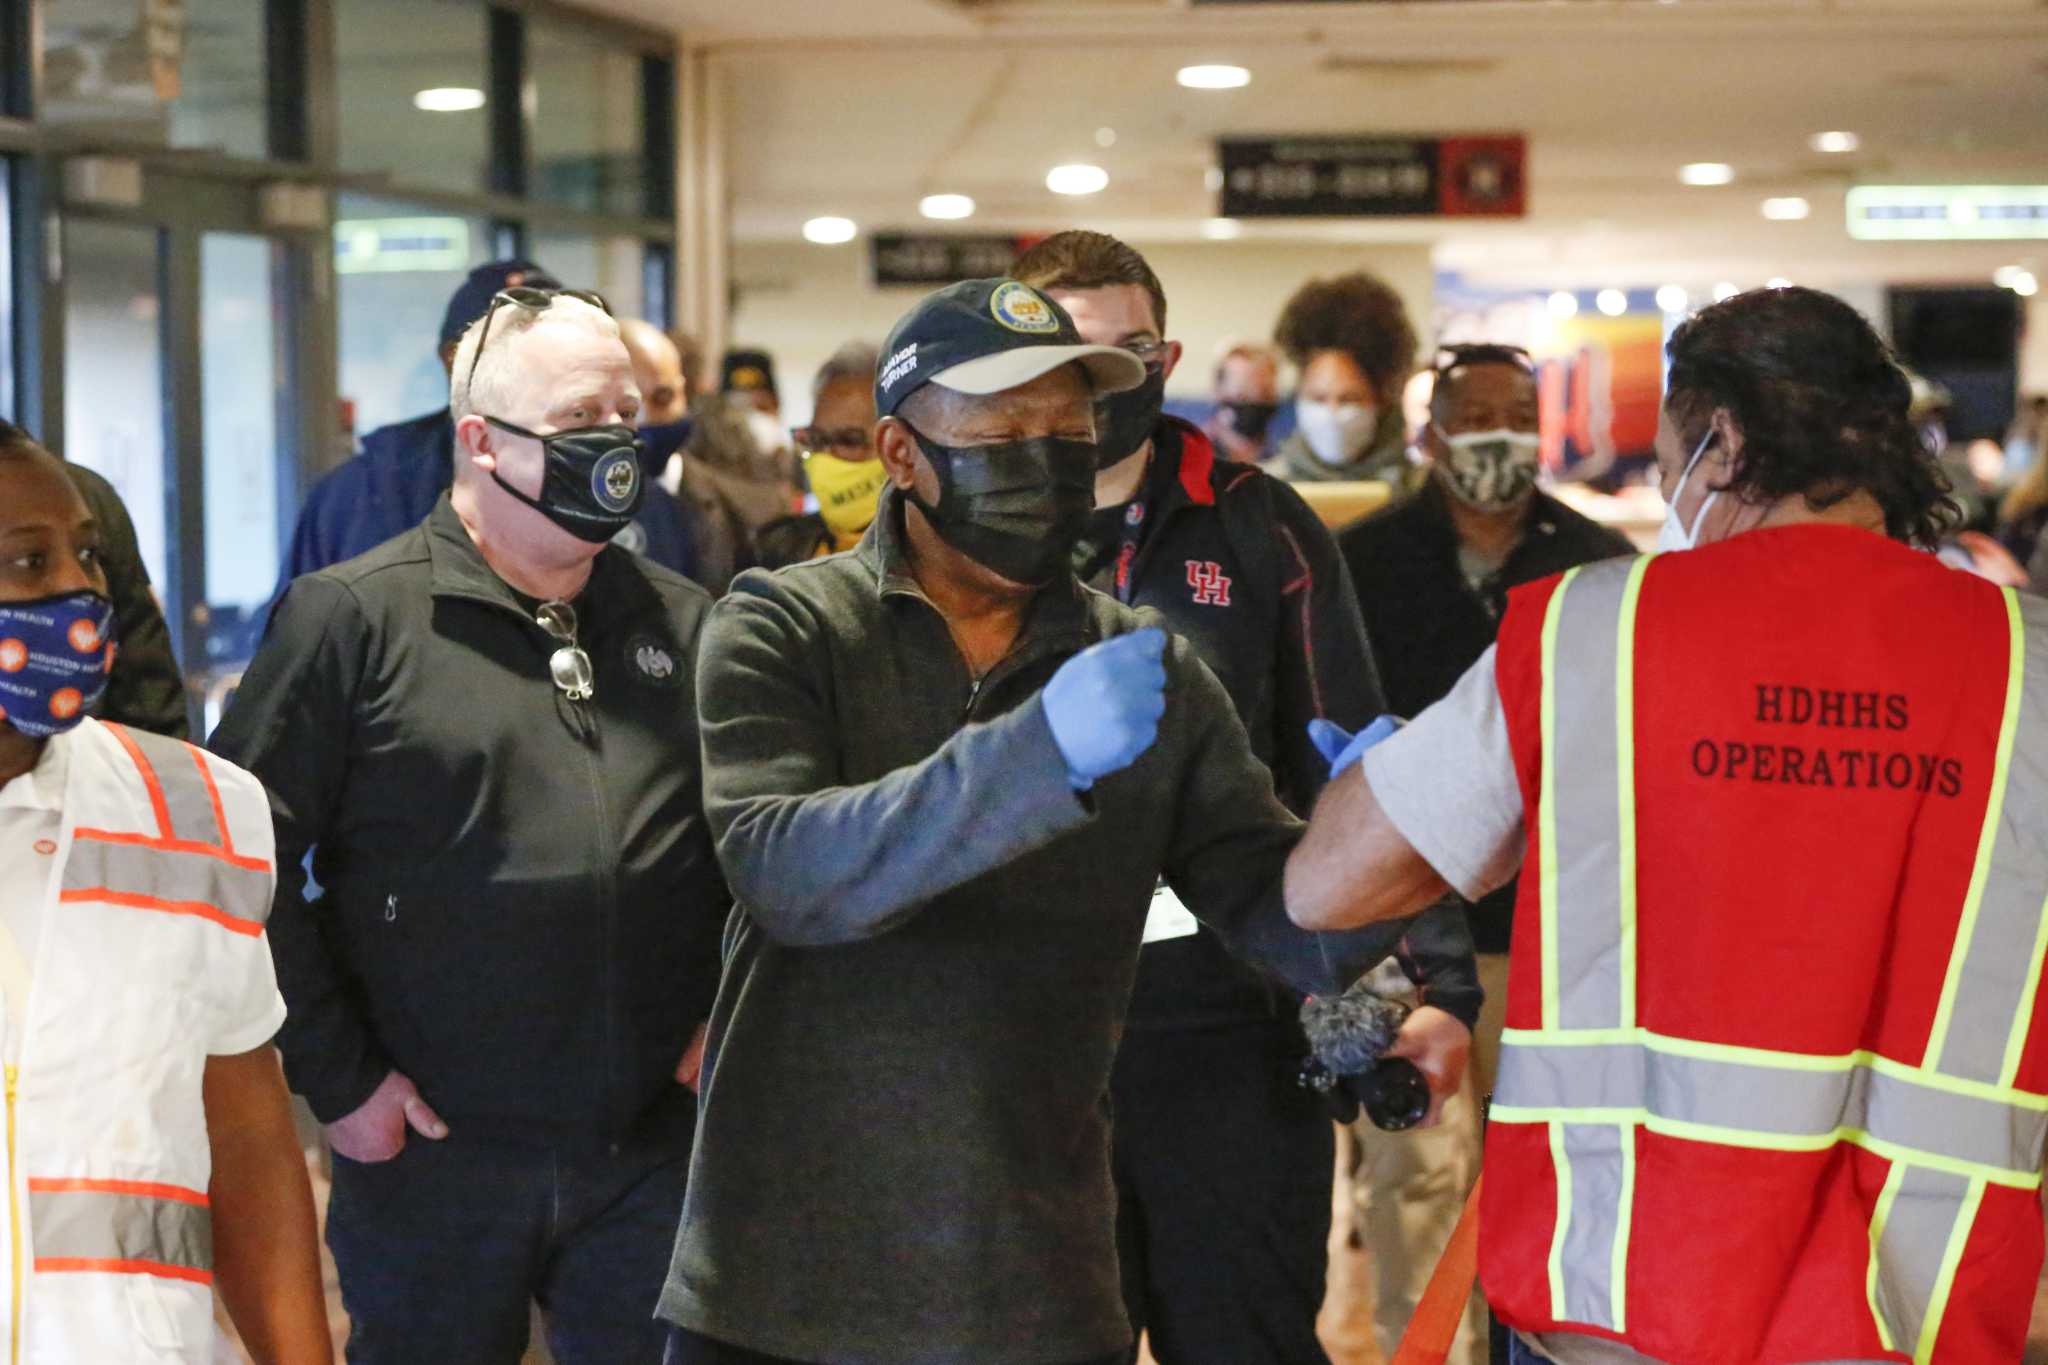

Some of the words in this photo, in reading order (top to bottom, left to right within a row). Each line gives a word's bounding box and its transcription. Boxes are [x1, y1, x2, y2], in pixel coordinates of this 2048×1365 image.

[880, 356, 918, 394] TURNER
[1185, 560, 1232, 606] UH
[1755, 683, 1909, 730] HDHHS
[1692, 739, 1963, 797] OPERATIONS
